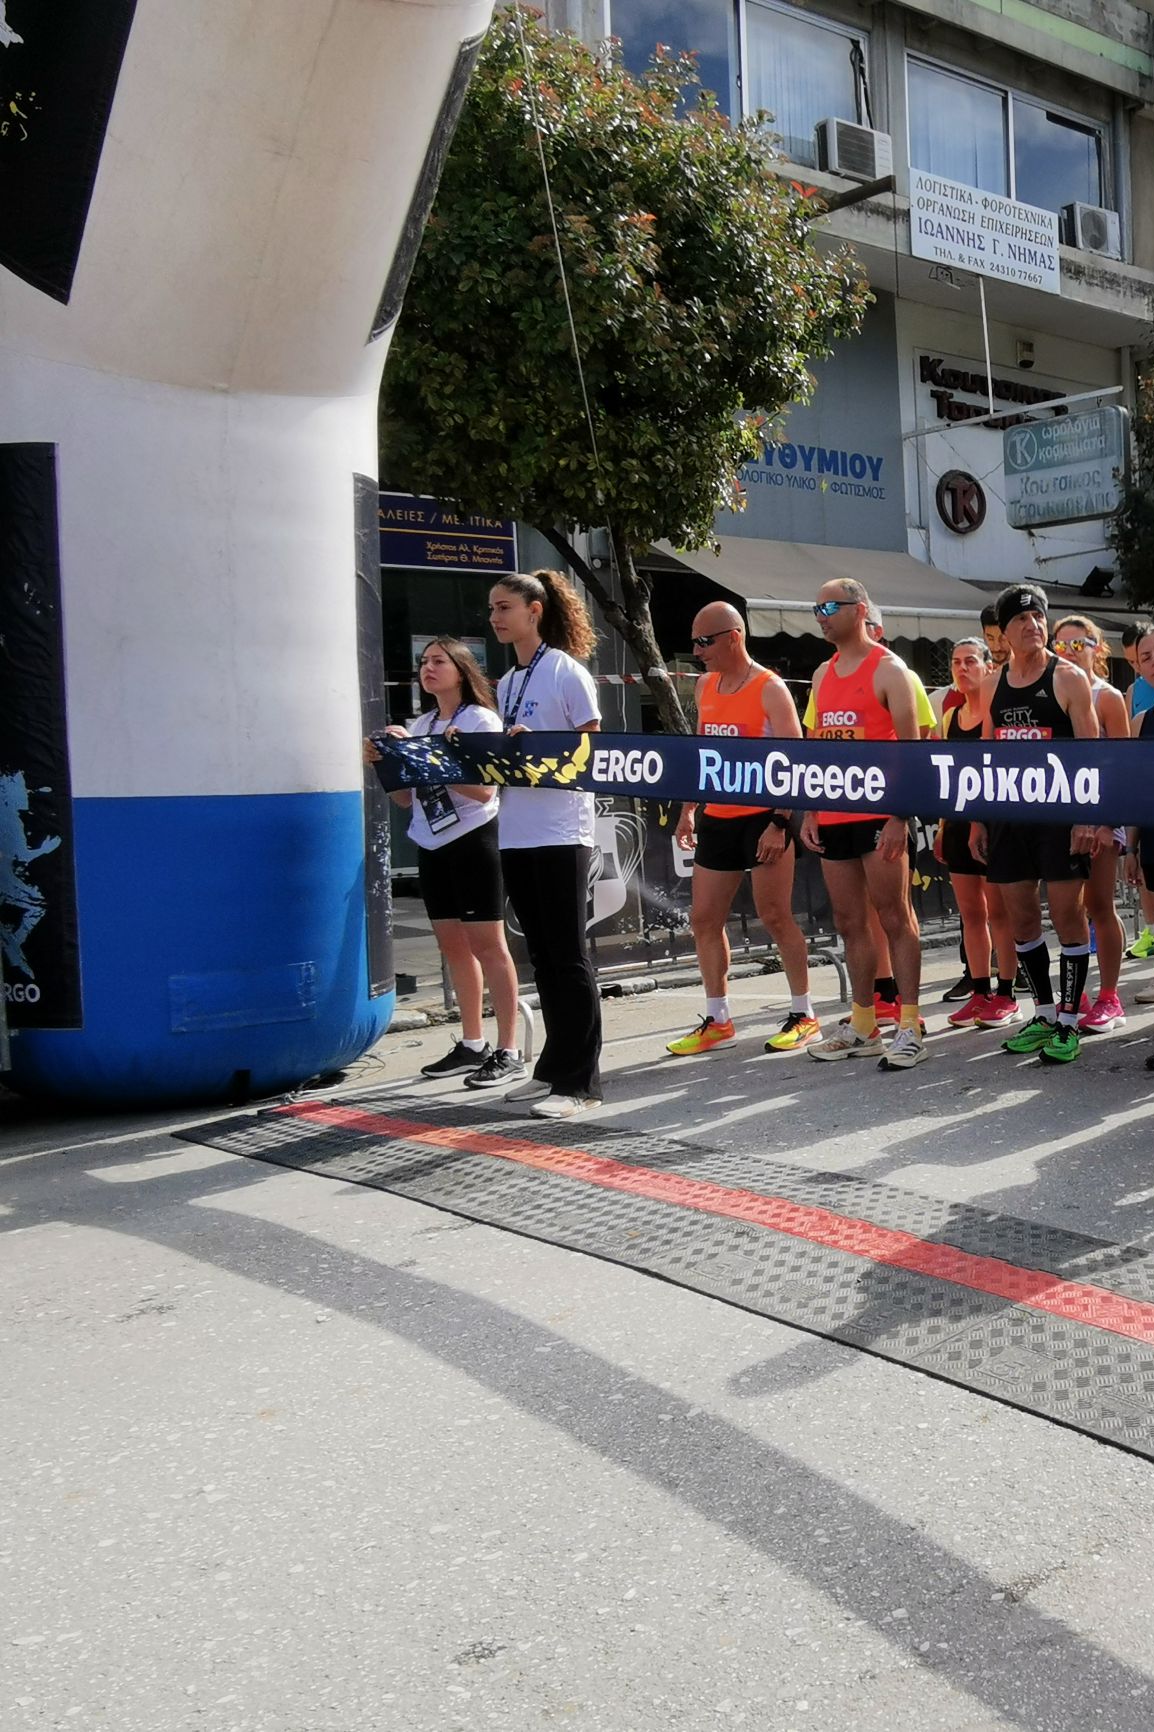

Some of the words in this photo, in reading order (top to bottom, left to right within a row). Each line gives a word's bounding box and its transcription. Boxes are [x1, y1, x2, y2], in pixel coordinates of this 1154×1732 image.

[916, 176, 973, 205] ΛΟΓΙΣΤΙΚΑ
[981, 197, 1053, 231] ΦΟΡΟΤΕΧΝΙΚΑ
[917, 196, 976, 226] ΟΡΓΑΝΩΣΗ
[980, 215, 1055, 249] ΕΠΙΧΕΙΡΗΣΕΩΝ
[918, 217, 986, 252] ΙΩΑΝΝΗΣ
[992, 238, 1004, 257] Γ.
[1007, 243, 1056, 272] ΝΗΜΑΣ
[958, 253, 966, 264] &
[967, 256, 986, 269] FAX
[989, 262, 1016, 277] 24310
[1018, 269, 1043, 285] 77667
[737, 469, 784, 487] ΟΛΟΓΙΚΟ
[786, 474, 817, 491] ΥΛΙΚΟ
[830, 481, 886, 500] ΦΩΤΙΣΜΟΣ
[377, 508, 425, 523] ΑΛΕΙΕΣ
[442, 514, 503, 529] ΜΕΙΤΙΚΑ
[822, 711, 857, 727] ERGO
[1004, 709, 1032, 723] CITY
[704, 724, 738, 736] ERGO
[1000, 728, 1042, 740] ERGO
[591, 749, 664, 784] ERGO
[698, 749, 886, 802] RunGreece
[930, 753, 1100, 812] Τρίκαλα
[0, 982, 41, 1003] RGO
